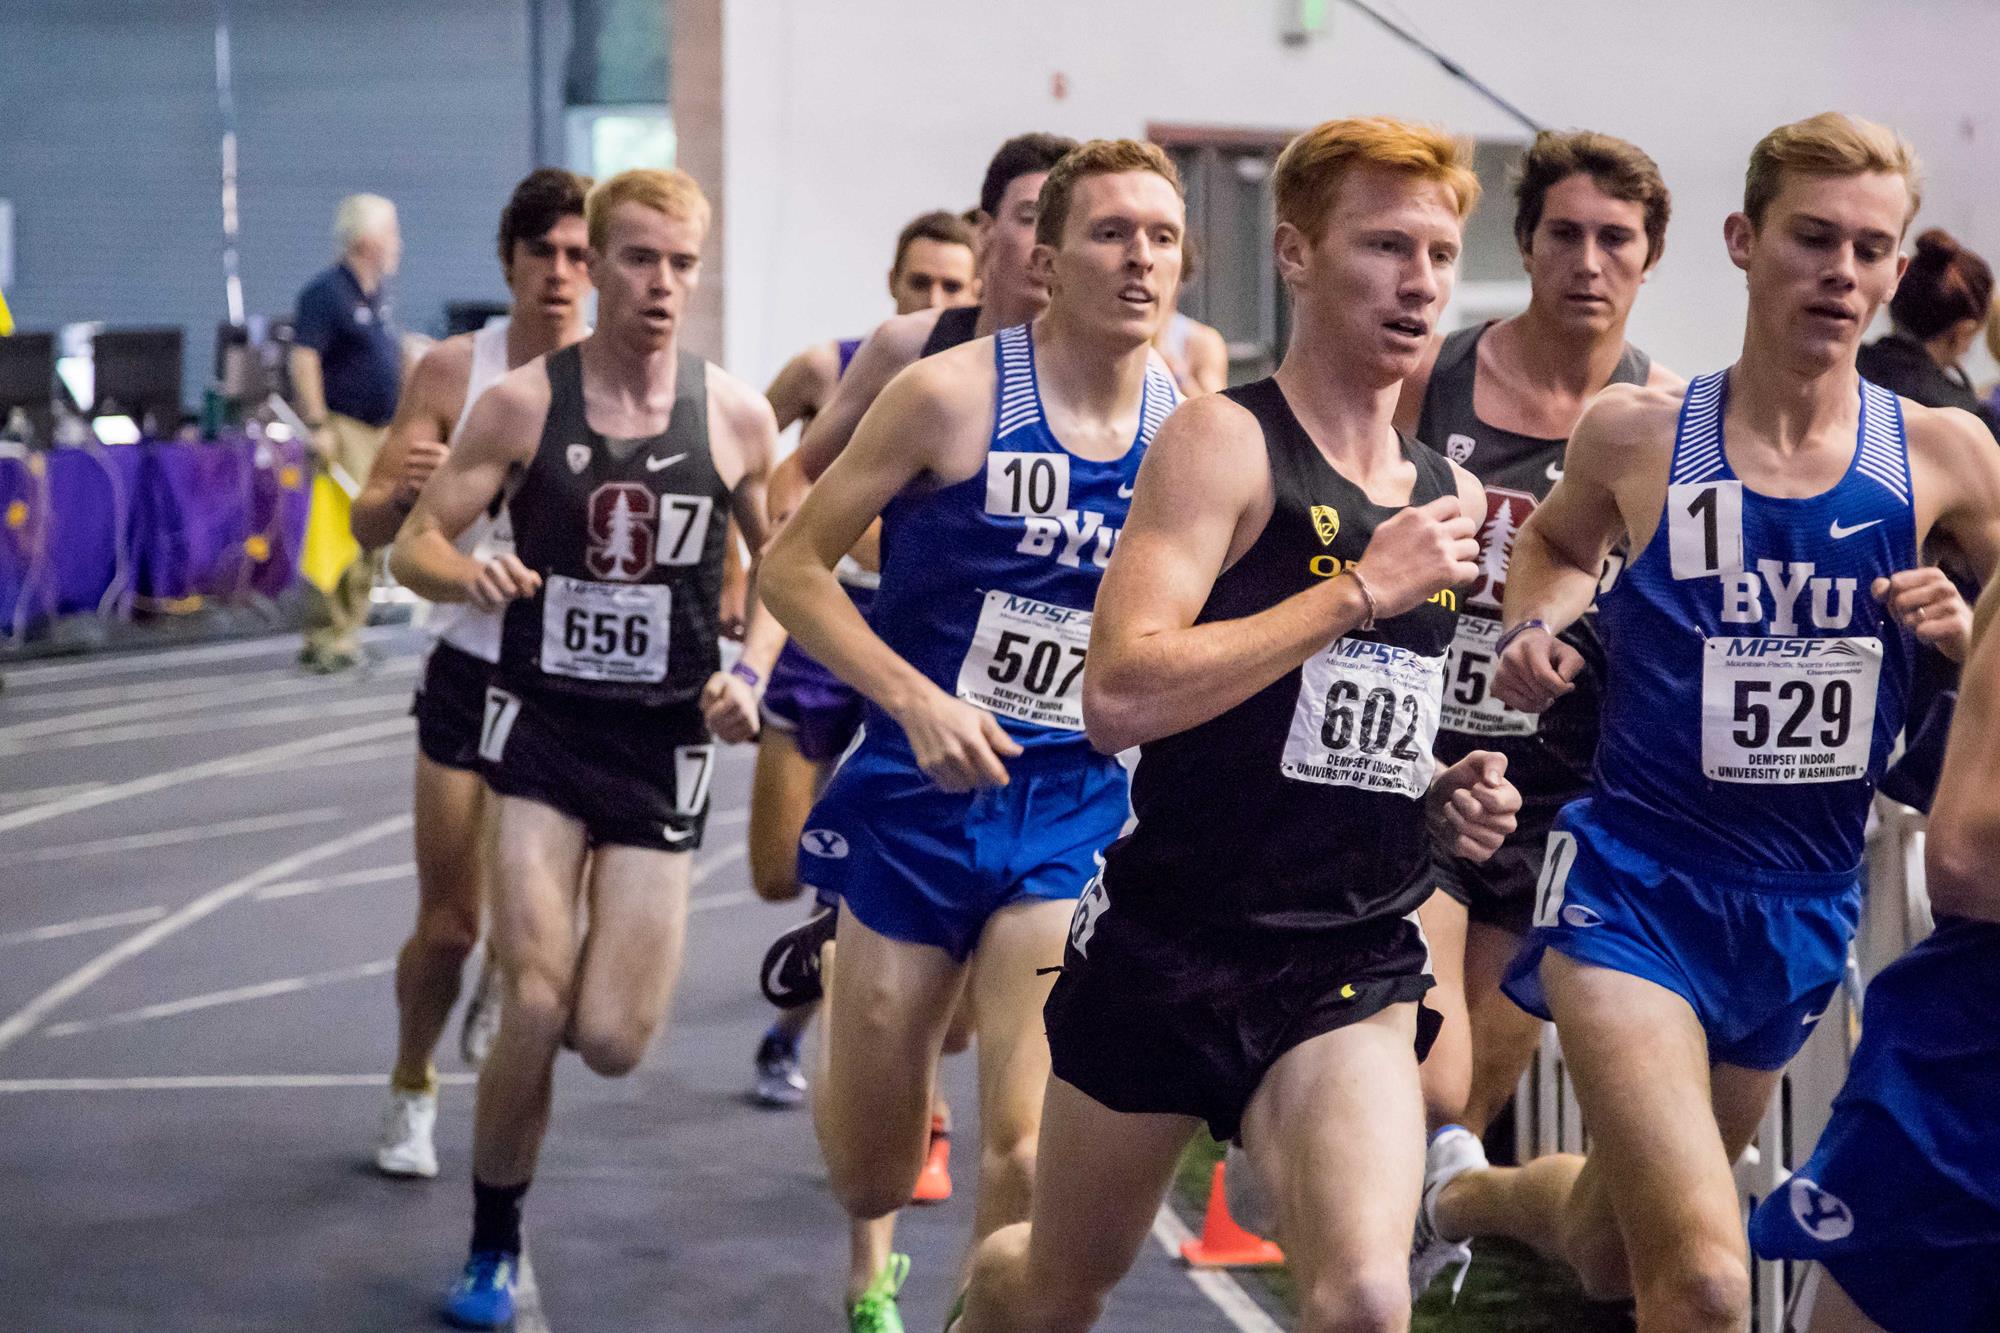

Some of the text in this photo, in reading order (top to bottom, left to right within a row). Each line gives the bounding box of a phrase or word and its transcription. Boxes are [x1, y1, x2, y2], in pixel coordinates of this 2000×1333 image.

[1004, 458, 1056, 514] 10
[672, 502, 699, 559] 7
[1687, 488, 1718, 571] 1
[1003, 594, 1080, 624] MPSF
[1720, 559, 1857, 636] BYU
[565, 607, 649, 657] 656
[1330, 637, 1407, 665] MPSF
[1726, 638, 1825, 658] MPSF
[987, 630, 1088, 698] 507
[1725, 660, 1766, 668] Mountain
[993, 687, 1033, 706] DEMPSEY
[1321, 680, 1419, 762] 602
[1733, 679, 1852, 748] 529
[484, 696, 509, 752] 7
[686, 751, 707, 809] 7
[1297, 762, 1352, 781] UNIVERSITY
[1352, 770, 1366, 783] OF
[1327, 753, 1370, 770] DEMPSEY
[1718, 764, 1857, 779] UNIVERSITY OF WASHINGTON
[1749, 752, 1836, 765] DEMPSEY INDOOR
